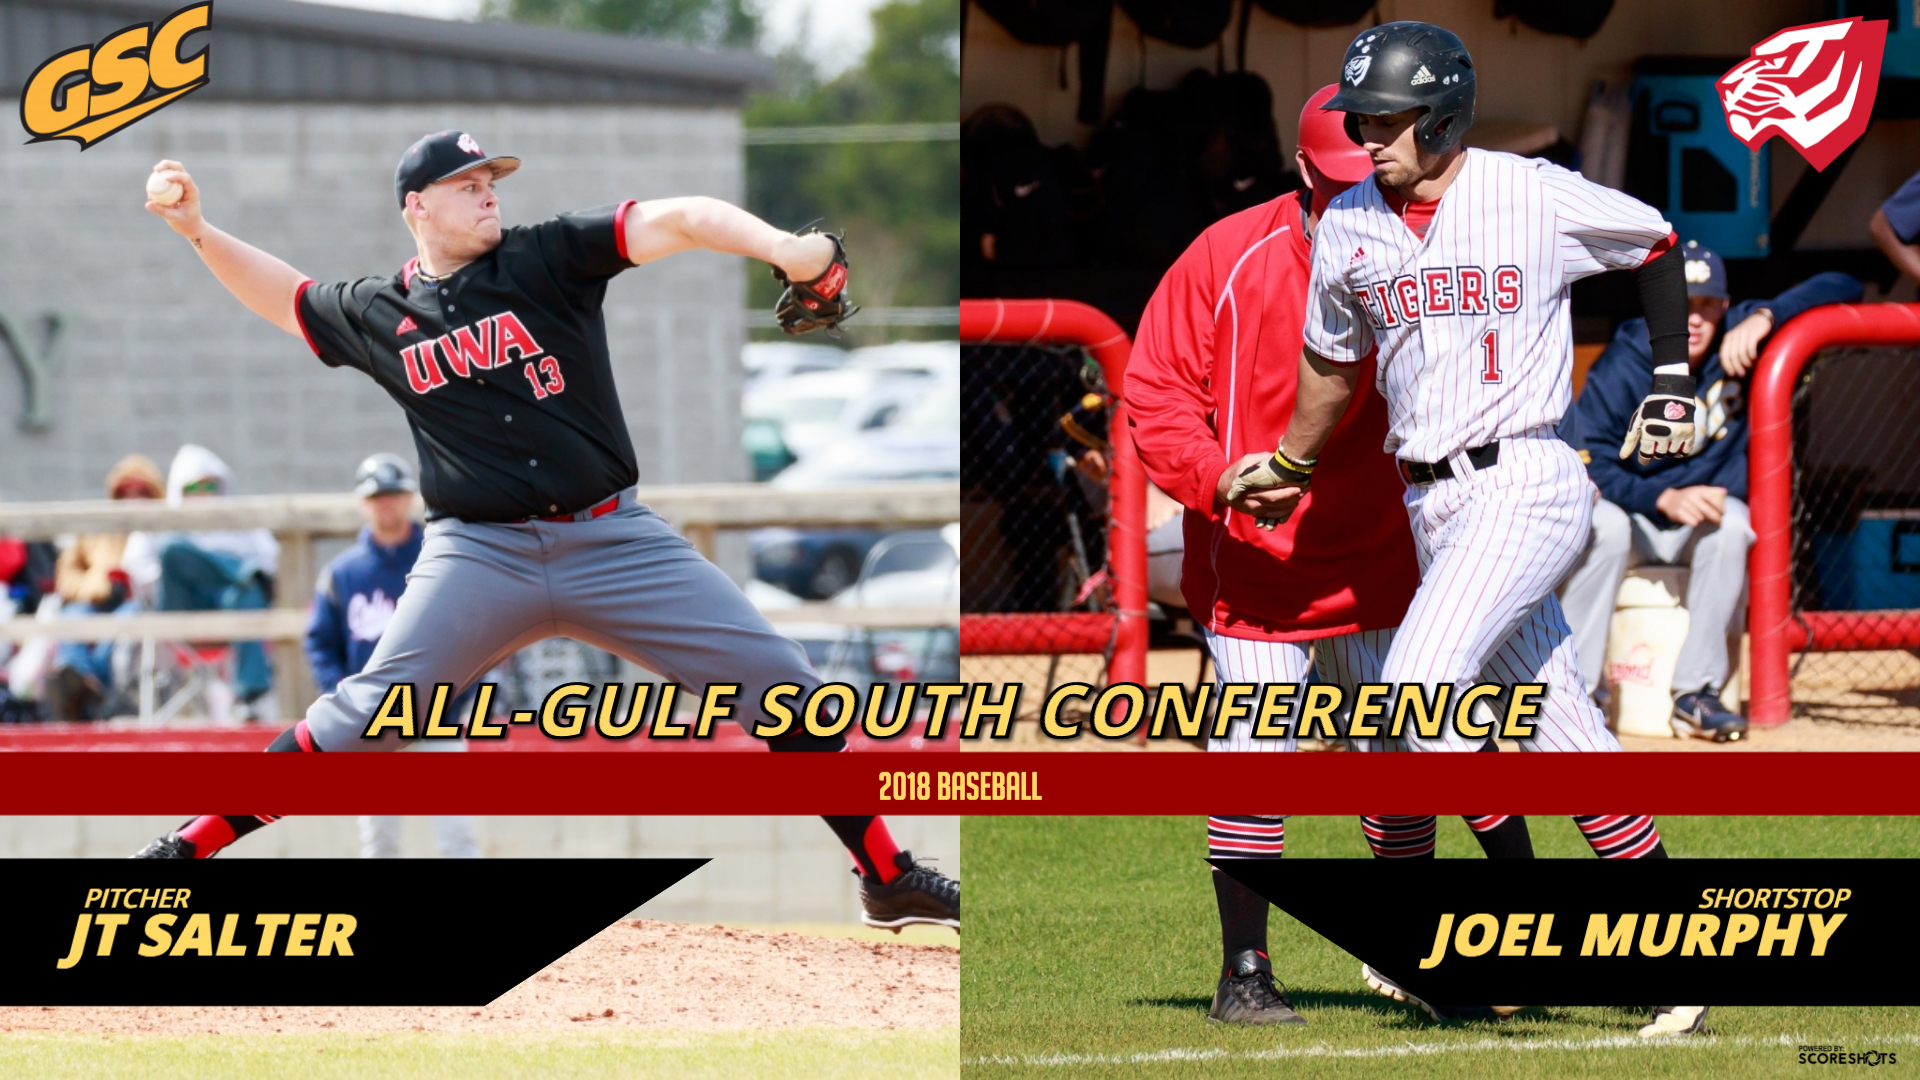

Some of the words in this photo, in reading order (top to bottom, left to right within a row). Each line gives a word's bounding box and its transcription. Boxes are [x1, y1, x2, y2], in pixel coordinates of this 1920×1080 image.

[1410, 73, 1436, 86] adidas
[1353, 265, 1522, 329] TIGERS
[399, 310, 543, 394] UWA
[524, 355, 565, 400] 13
[1481, 329, 1502, 384] 1
